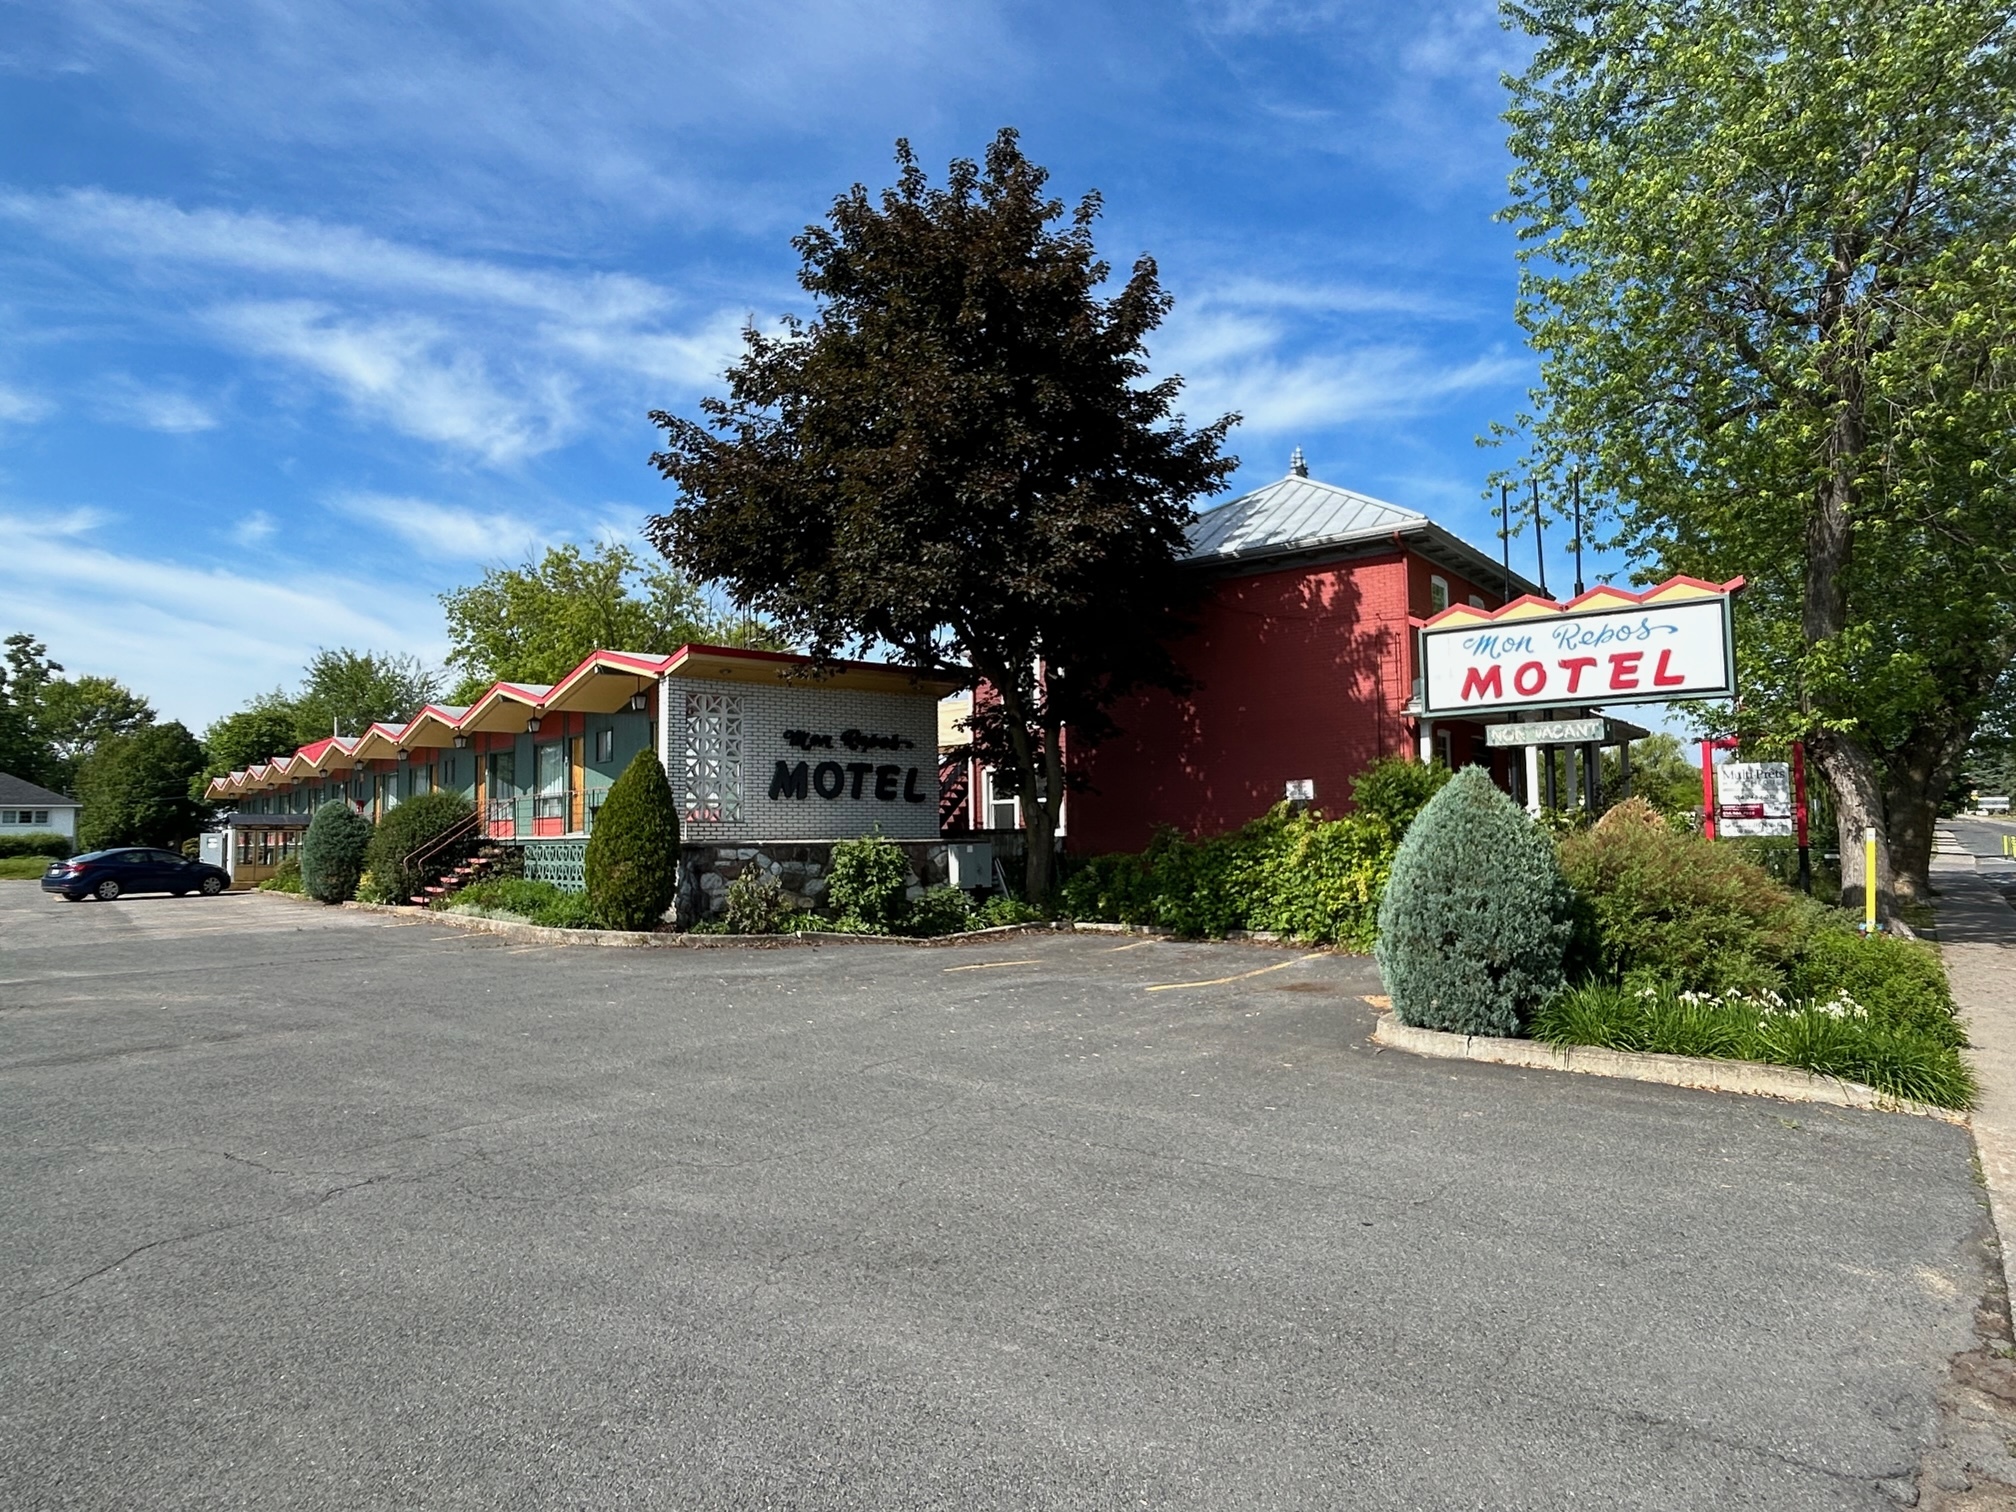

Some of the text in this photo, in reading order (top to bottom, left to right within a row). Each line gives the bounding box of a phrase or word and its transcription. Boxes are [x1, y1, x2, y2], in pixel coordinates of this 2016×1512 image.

[1463, 617, 1679, 659] Mon Repos
[1460, 648, 1685, 701] MOTEL
[768, 760, 926, 803] MOTEL
